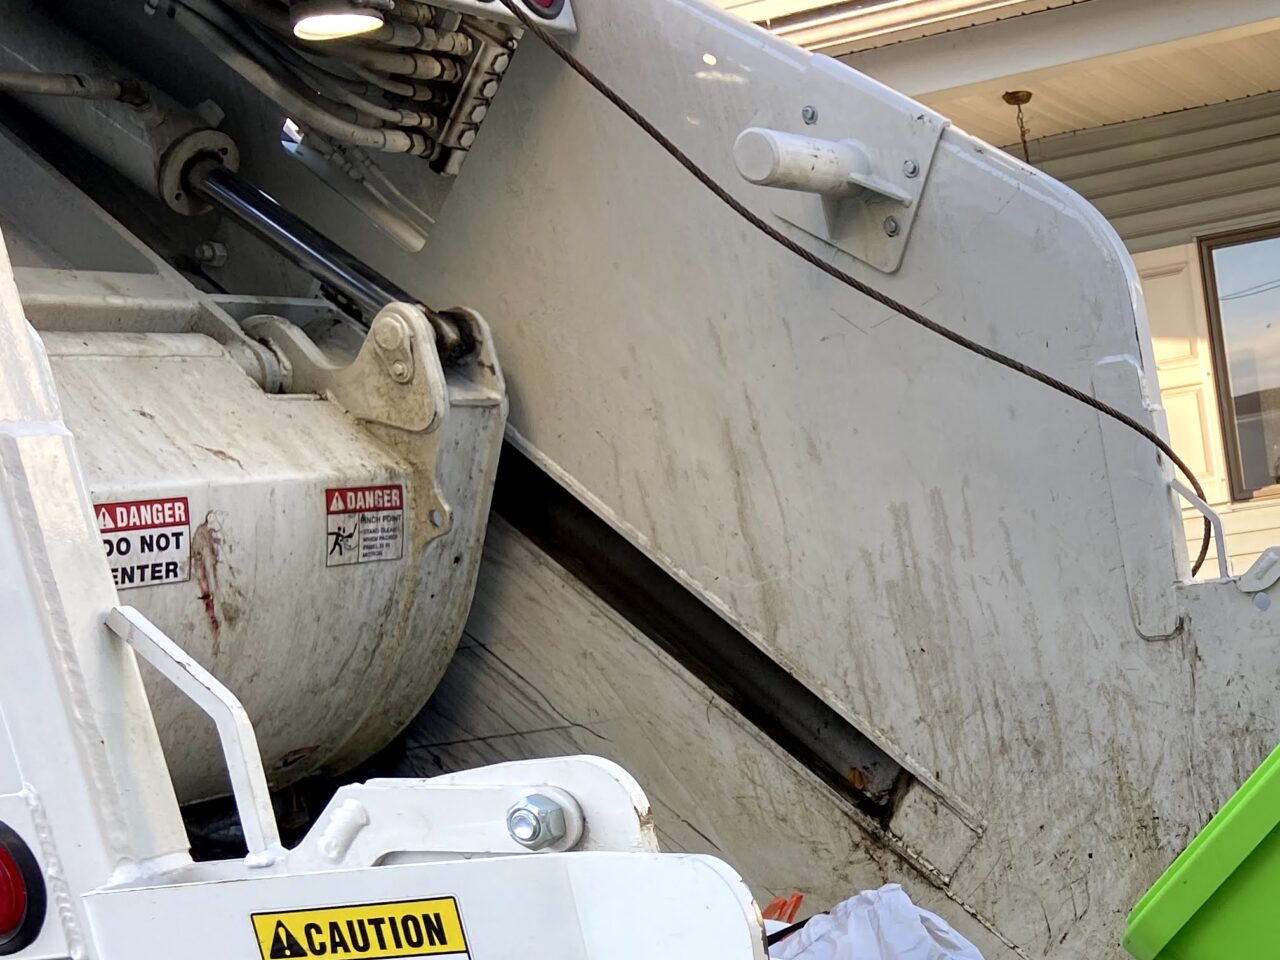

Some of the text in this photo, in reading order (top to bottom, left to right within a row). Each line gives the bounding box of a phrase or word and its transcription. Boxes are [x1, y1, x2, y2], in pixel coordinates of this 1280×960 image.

[347, 489, 400, 510] DANGER
[116, 502, 186, 527] DANGER
[140, 531, 184, 553] NOT
[304, 913, 447, 956] CAUTION
